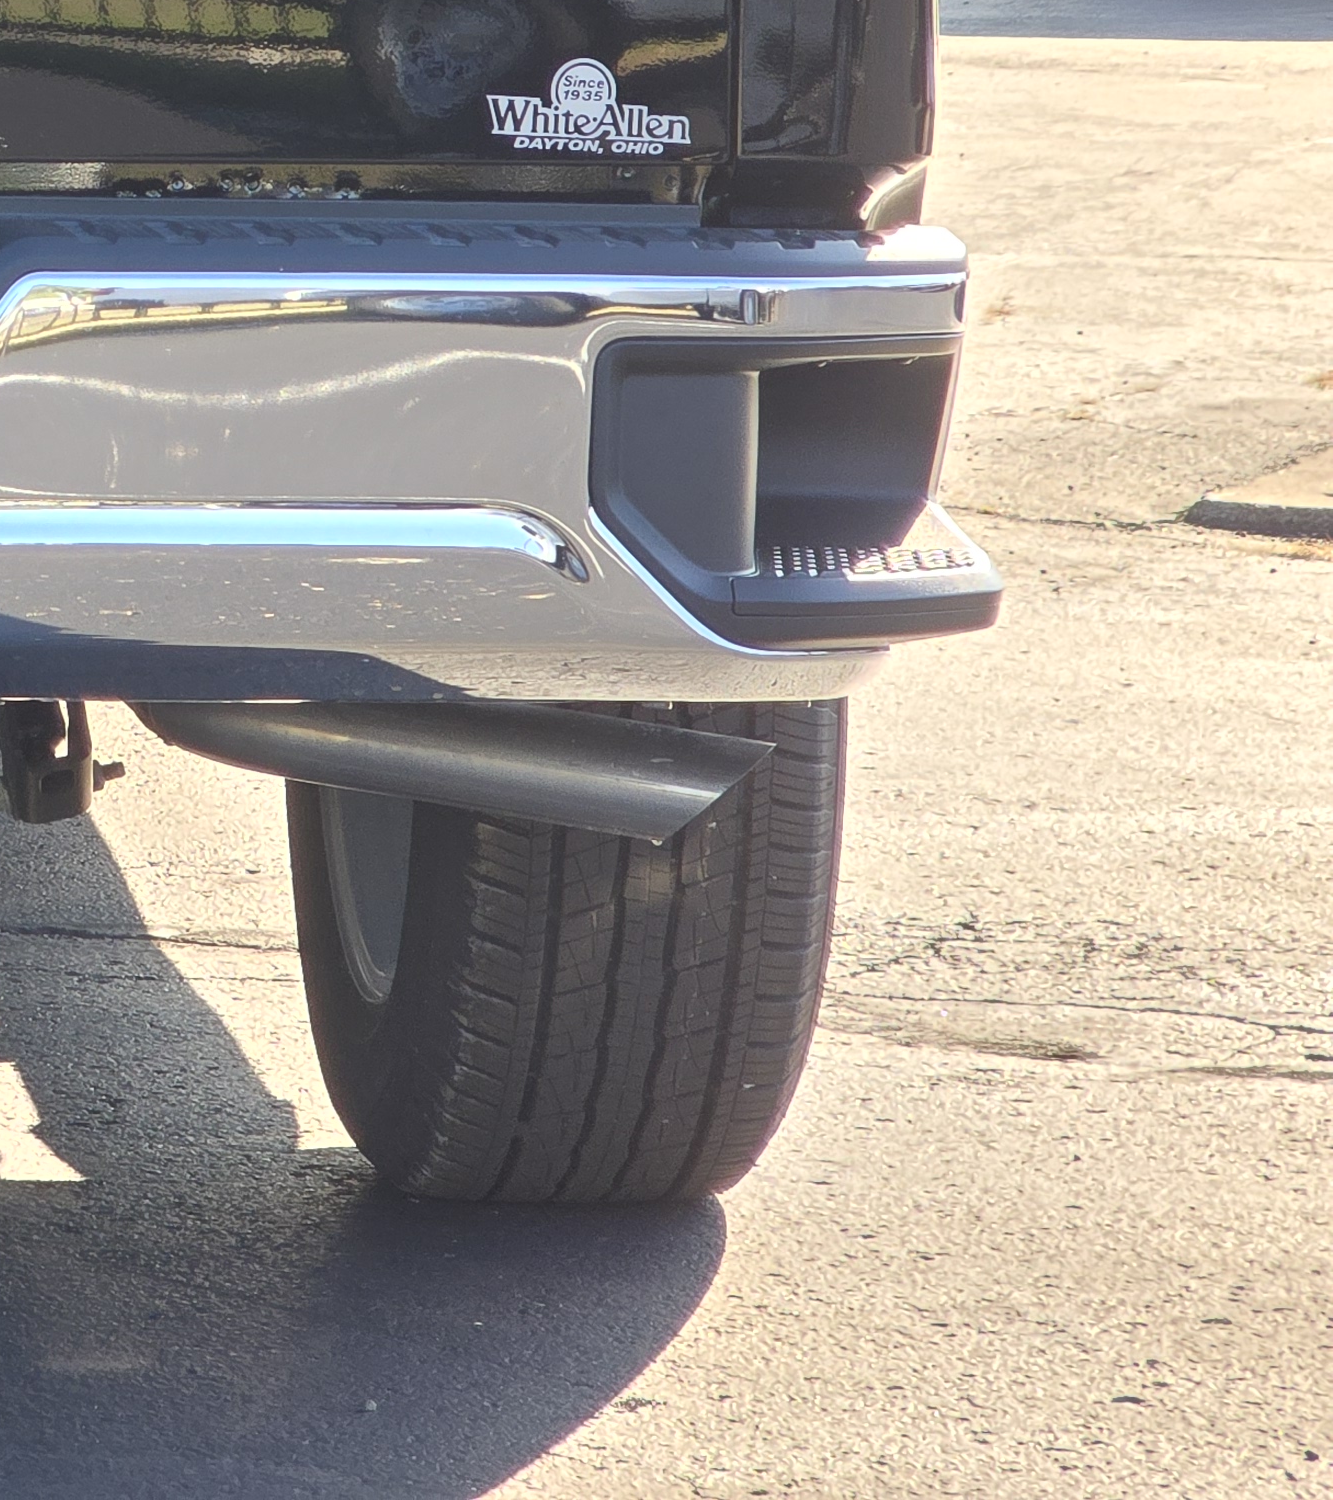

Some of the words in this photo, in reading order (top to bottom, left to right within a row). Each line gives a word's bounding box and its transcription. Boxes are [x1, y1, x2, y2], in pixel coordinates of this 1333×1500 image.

[563, 74, 605, 90] Since
[562, 89, 604, 102] 1935
[513, 136, 604, 155] DAYTON,
[611, 141, 665, 155] OHIO
